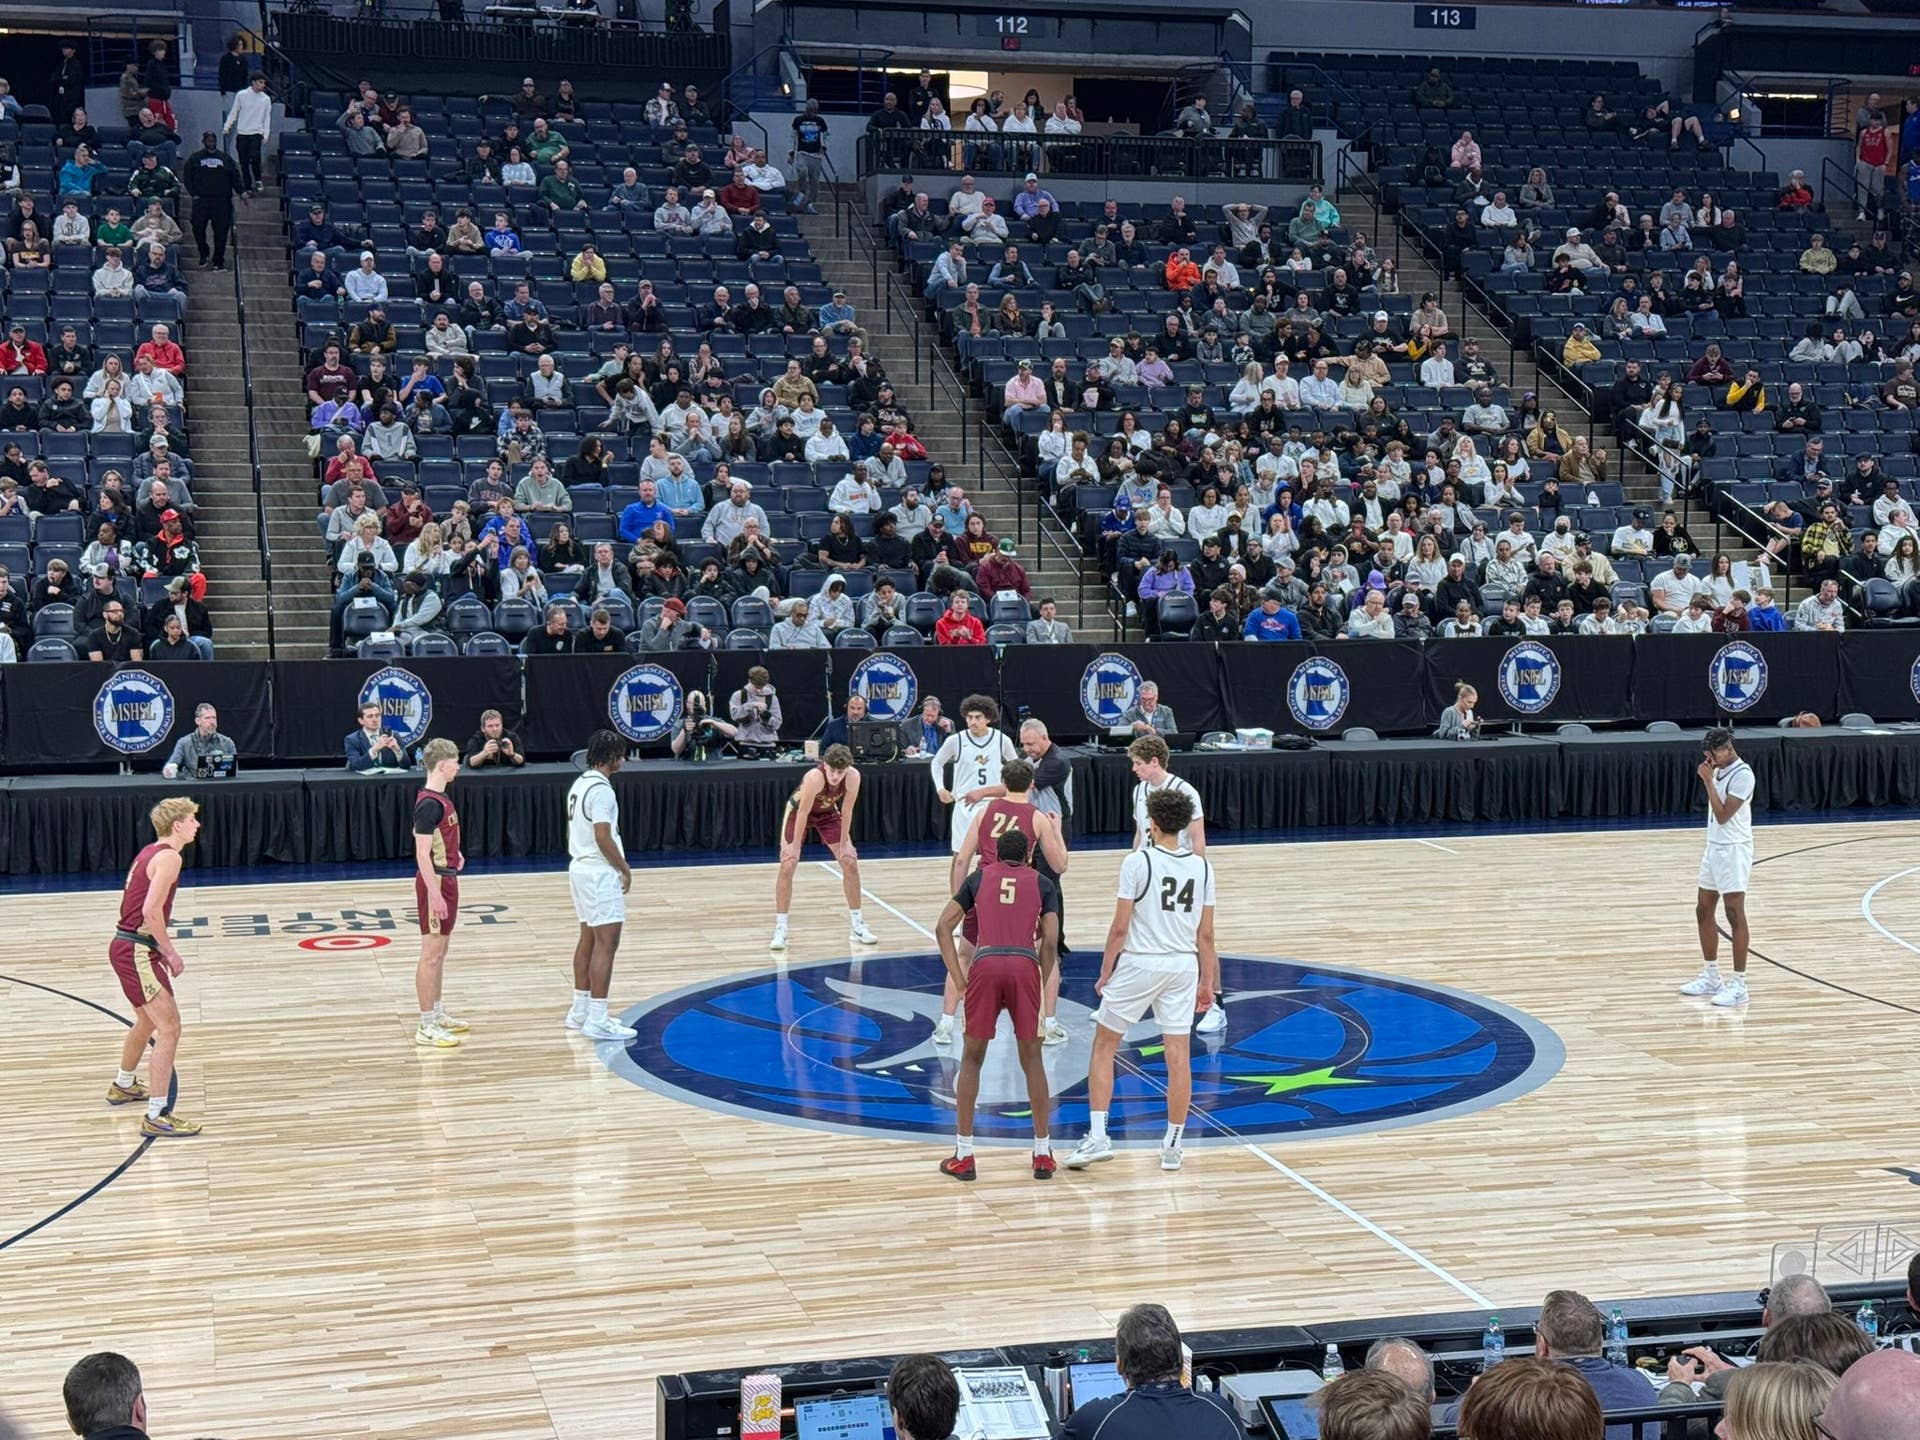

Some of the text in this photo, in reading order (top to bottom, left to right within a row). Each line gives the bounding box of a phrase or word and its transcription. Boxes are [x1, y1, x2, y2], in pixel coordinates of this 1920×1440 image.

[995, 16, 1028, 34] 112
[1431, 9, 1460, 26] 113
[105, 672, 161, 691] MINNESOTA
[624, 692, 668, 712] MSHSL
[111, 702, 157, 722] MSHSL
[978, 768, 988, 785] 5
[1000, 877, 1017, 905] 5
[1161, 876, 1195, 913] 24
